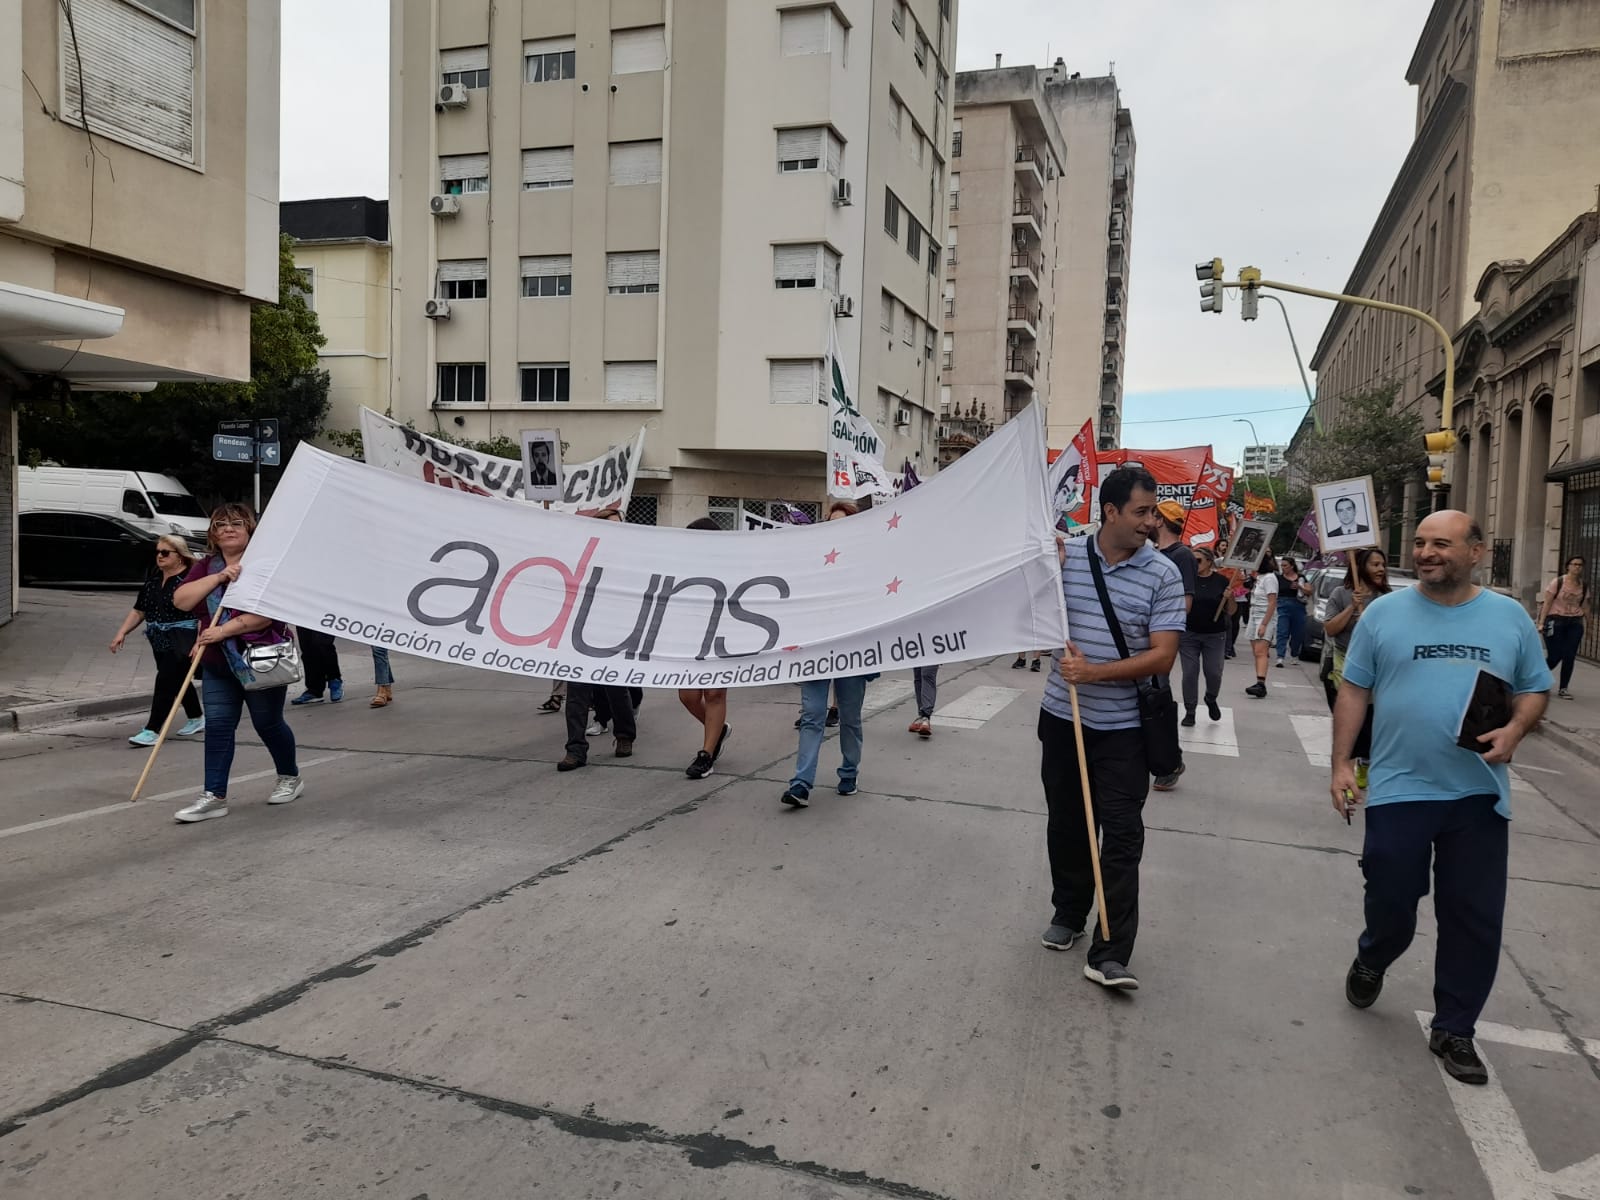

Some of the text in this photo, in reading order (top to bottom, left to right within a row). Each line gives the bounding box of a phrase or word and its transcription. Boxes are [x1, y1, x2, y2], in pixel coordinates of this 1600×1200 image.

[1156, 484, 1197, 496] RENTE
[406, 536, 790, 662] aduns
[320, 612, 969, 687] asociación de docentes de la universidad nacional del sur
[1412, 644, 1490, 663] RESISTE
